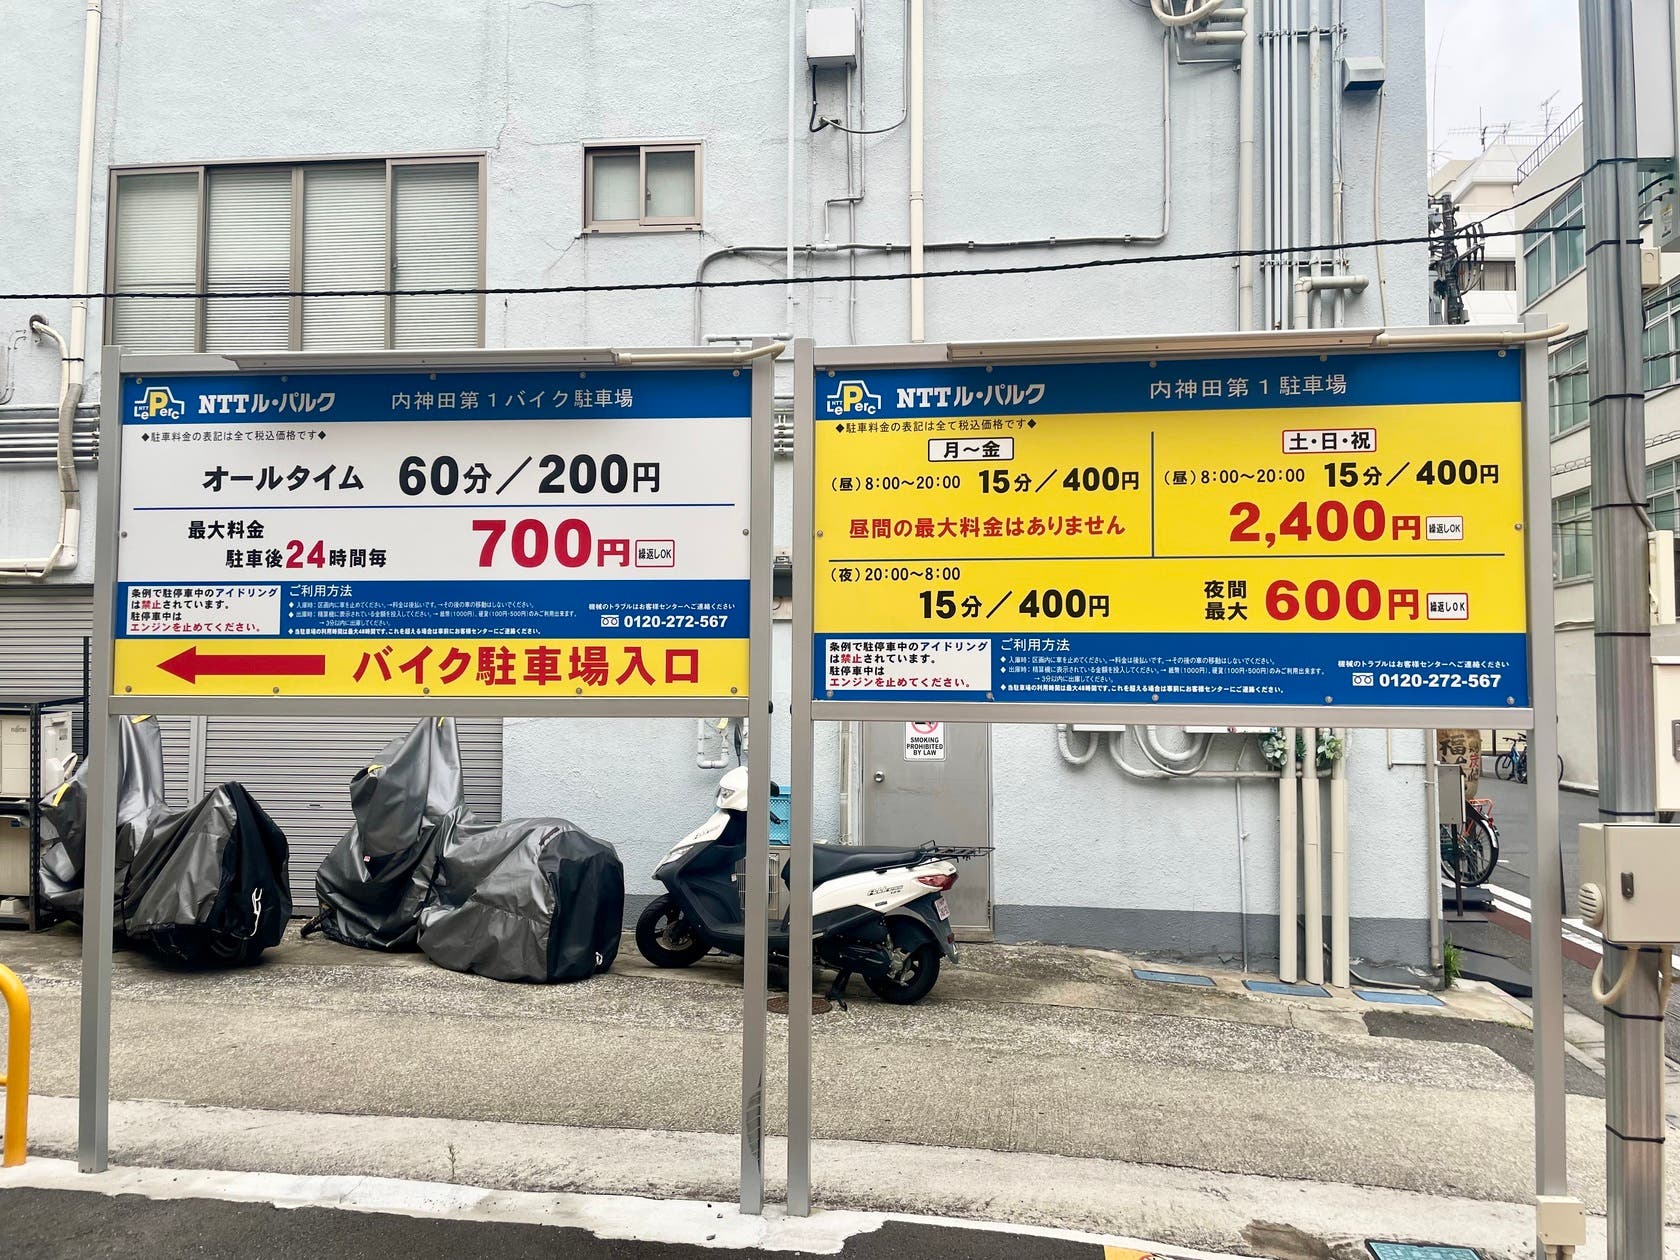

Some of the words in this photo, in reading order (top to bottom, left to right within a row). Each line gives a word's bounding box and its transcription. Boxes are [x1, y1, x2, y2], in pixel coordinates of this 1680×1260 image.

[1149, 373, 1347, 399] 内神田第1駐車場
[391, 388, 634, 411] 内神田第1バイク駐車場
[202, 464, 365, 492] オールタイム
[187, 520, 265, 540] 最大料金
[849, 515, 1126, 539] 昼間の最大料金はありません
[471, 518, 630, 568] 700円
[225, 539, 388, 569] 駐車後24時間毎
[131, 588, 279, 599] 条例で駐停車中のアイドリング
[289, 584, 353, 597] ご利用方法
[1203, 580, 1248, 599] 夜間
[1265, 579, 1420, 622] 600円
[130, 612, 182, 622] 駐停車中は
[1204, 601, 1249, 621] 最大
[130, 623, 262, 633] エンジンを止めてください。
[624, 615, 728, 628] 0120-272-567
[829, 641, 988, 652] 条例で駐停車中のアイドリング
[1001, 638, 1070, 651] ご利用方法
[353, 645, 699, 687] バイク駐車場入口
[829, 665, 885, 676] 駐停車中は
[829, 676, 972, 688] エンジンを止めてください。
[1379, 673, 1501, 688] 0120-272-567
